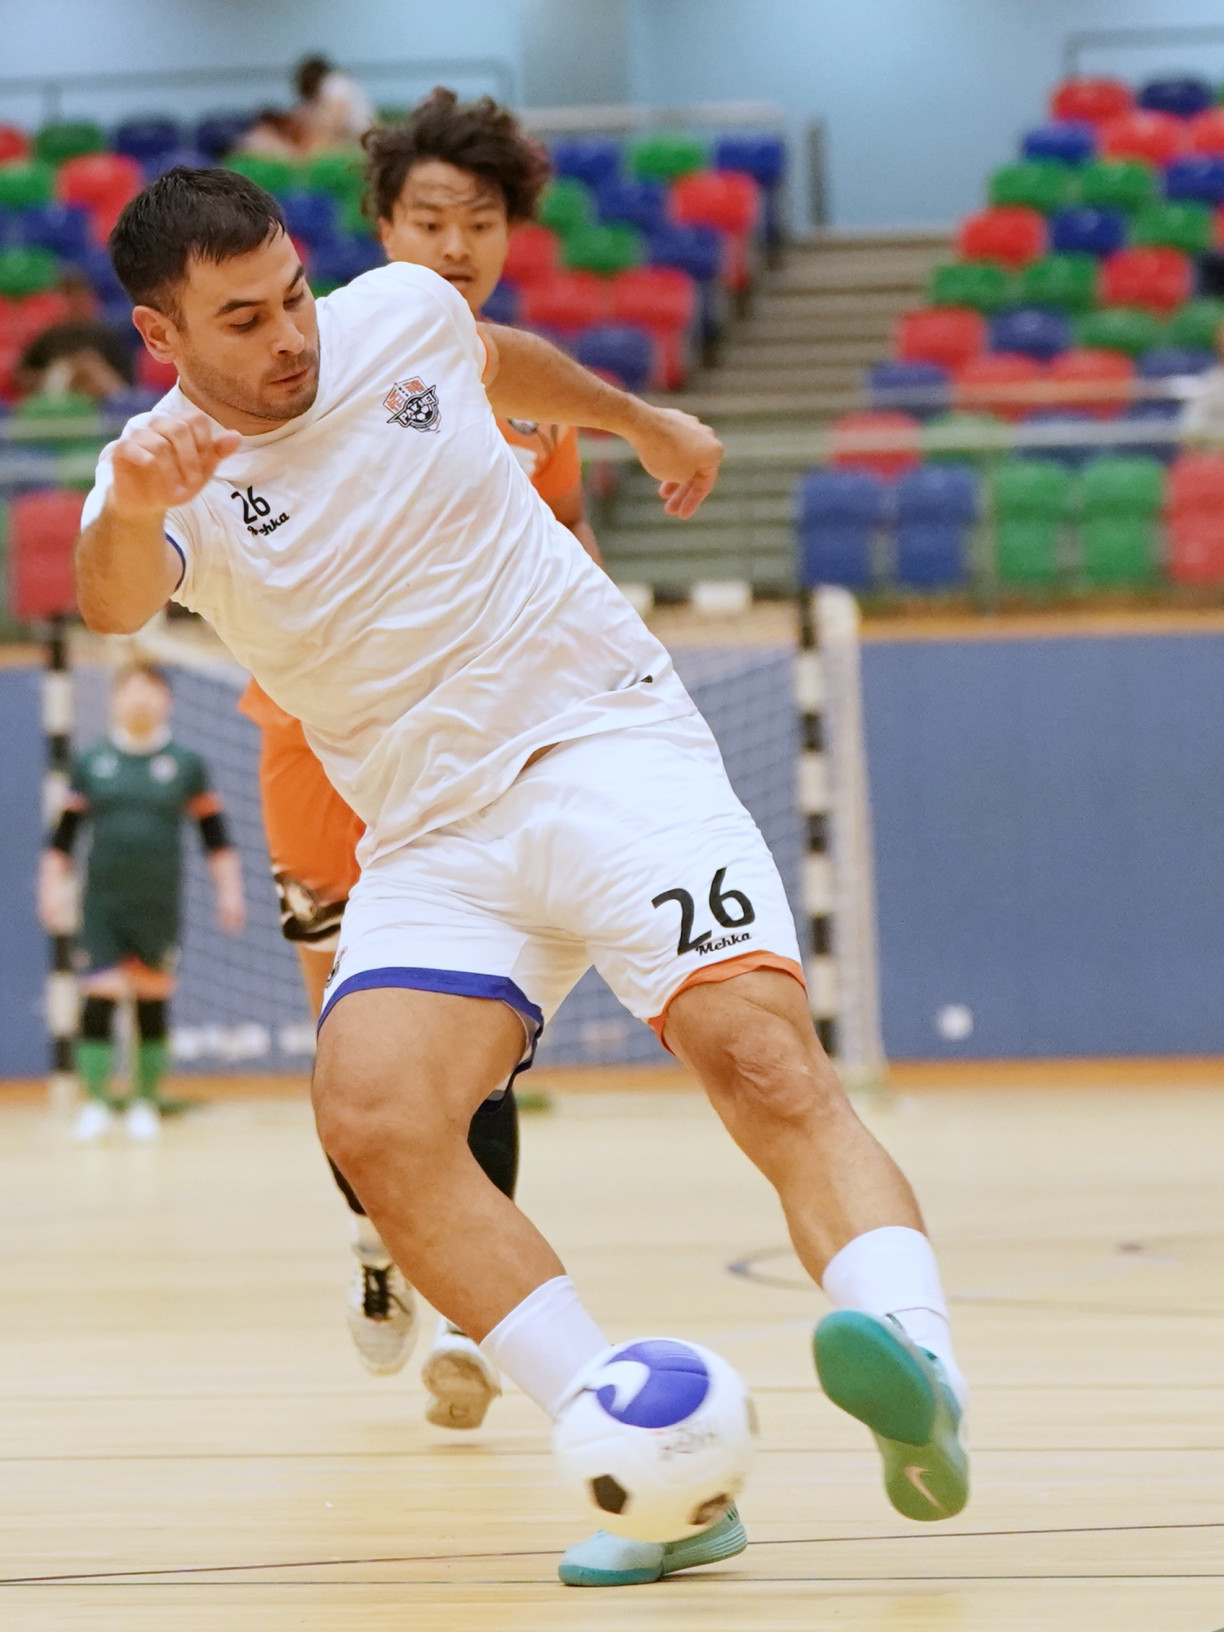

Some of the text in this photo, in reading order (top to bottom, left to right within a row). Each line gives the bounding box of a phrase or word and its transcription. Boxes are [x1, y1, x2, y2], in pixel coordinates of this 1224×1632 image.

[230, 486, 271, 525] 26
[651, 867, 756, 957] 26
[695, 931, 753, 956] Mehka
